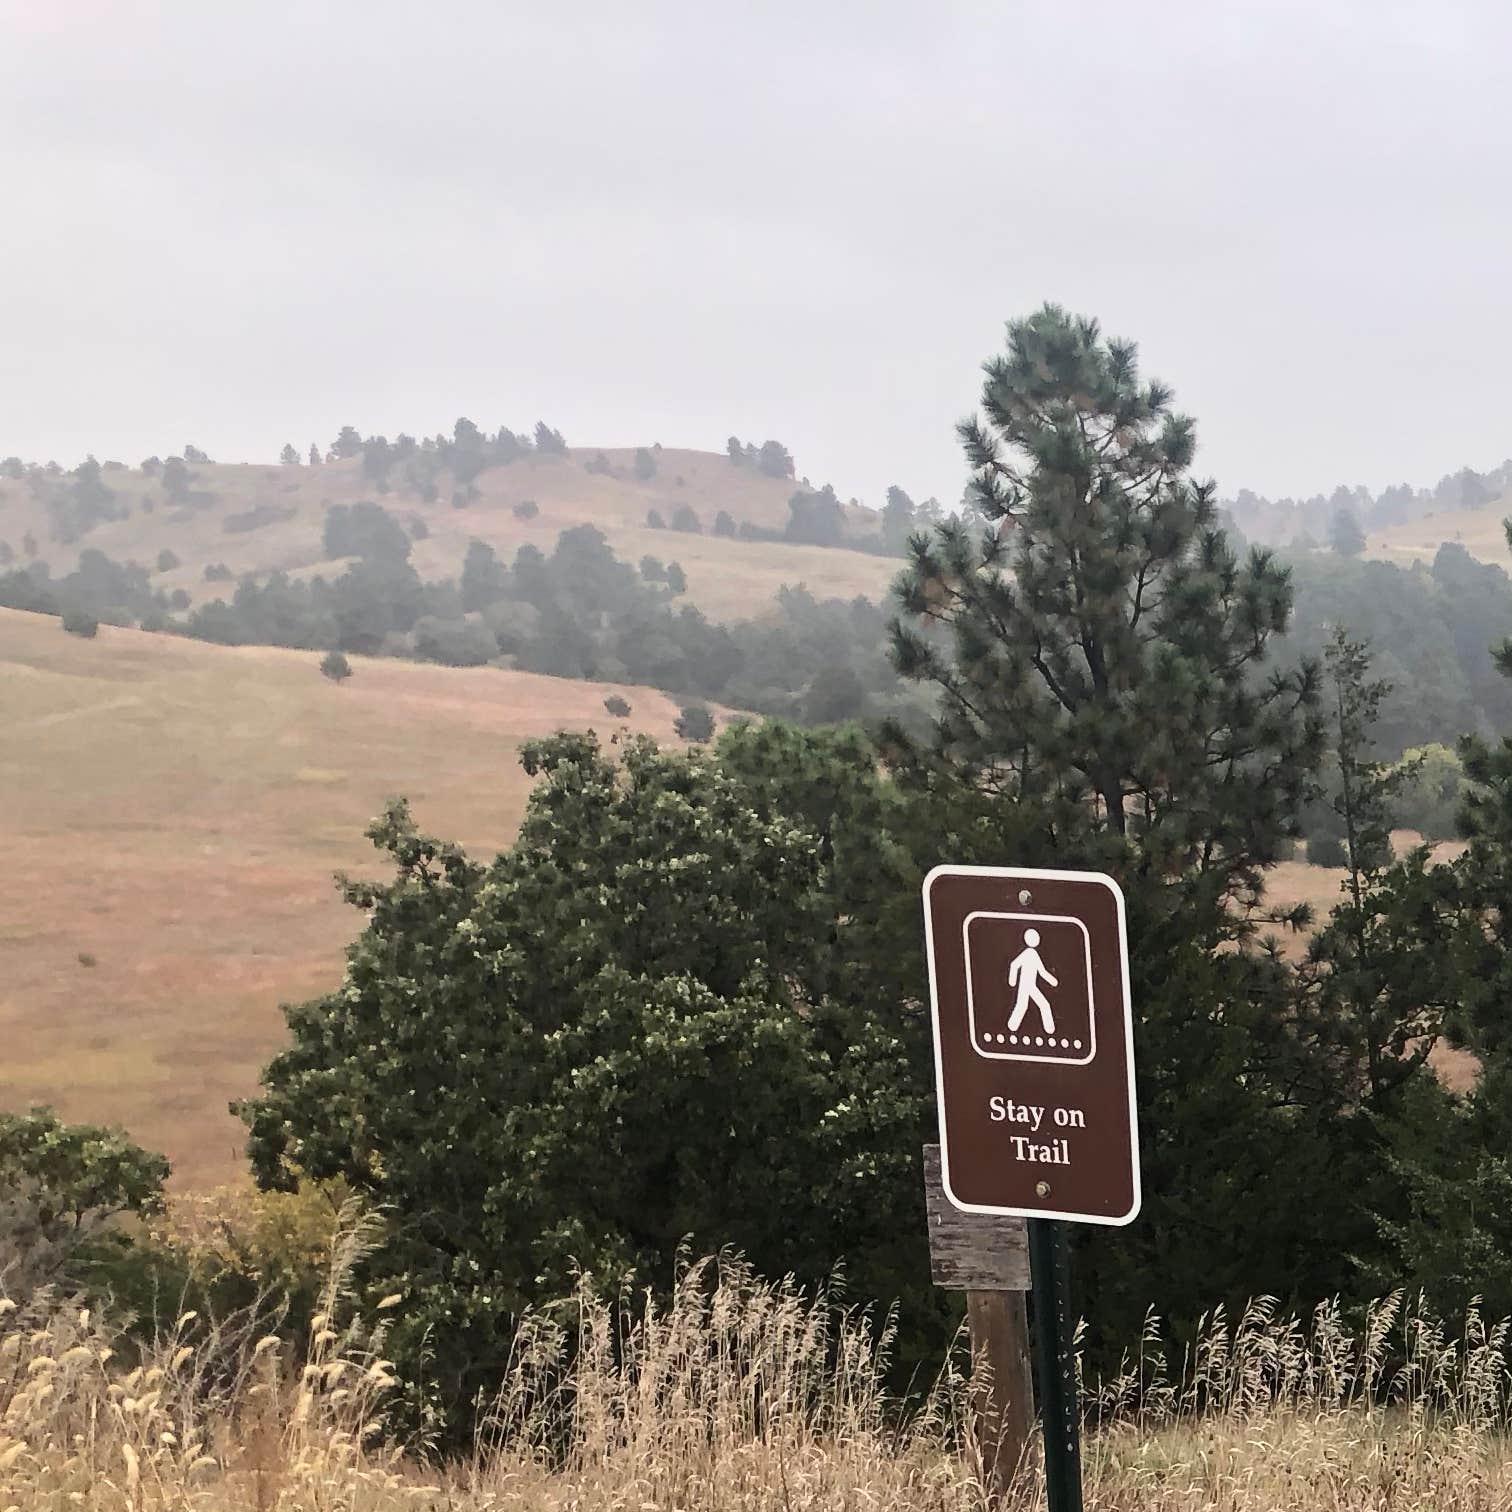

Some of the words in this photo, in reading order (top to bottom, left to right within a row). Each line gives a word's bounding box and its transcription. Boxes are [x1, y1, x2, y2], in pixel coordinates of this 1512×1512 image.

[990, 1096, 1045, 1131] Stay
[1054, 1108, 1086, 1127] on
[1010, 1136, 1070, 1165] Trail
